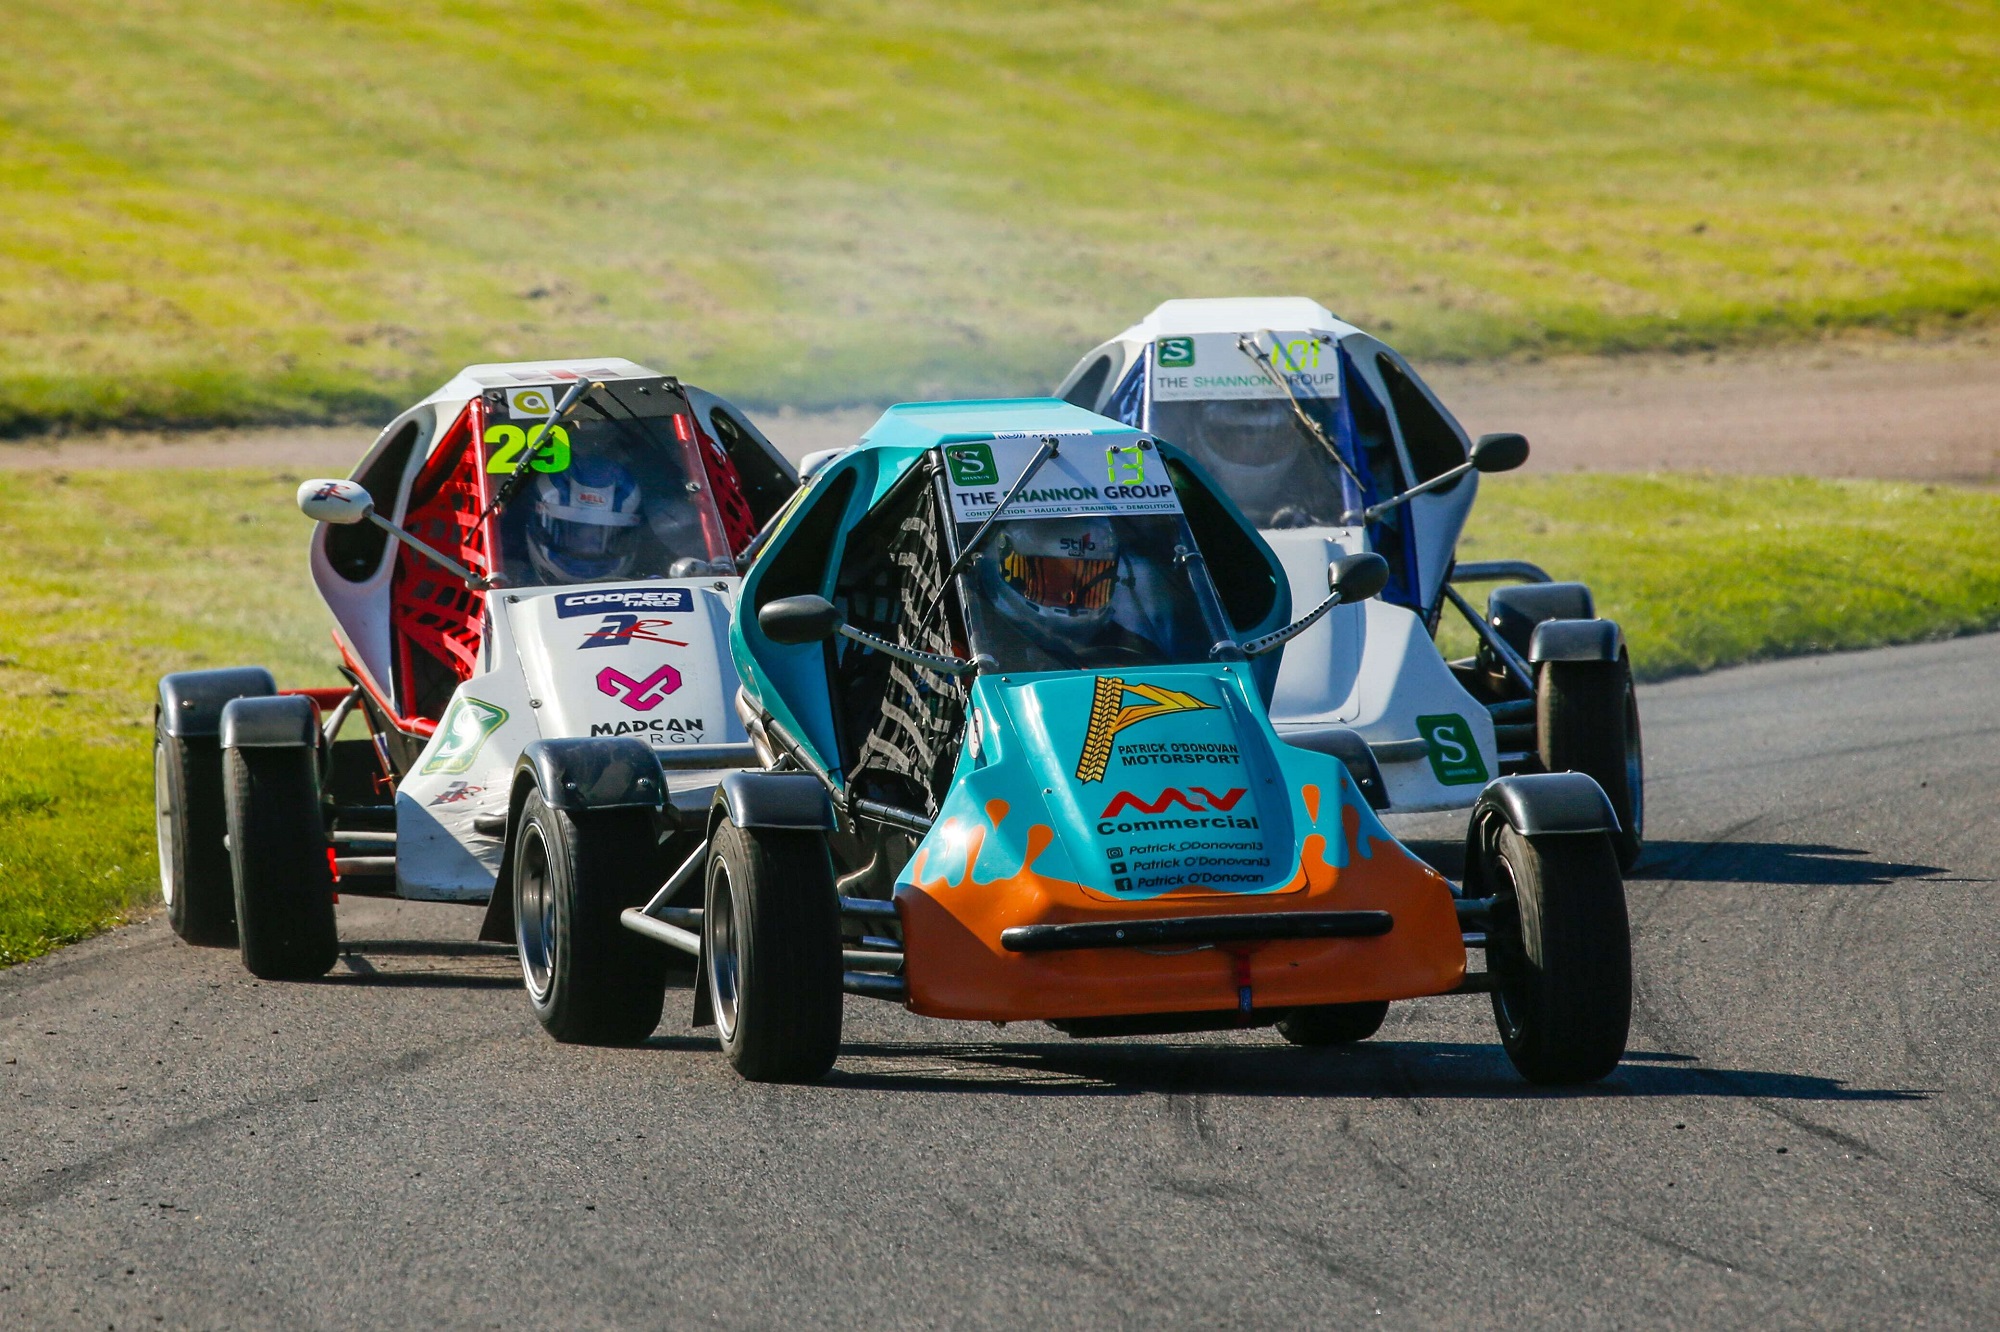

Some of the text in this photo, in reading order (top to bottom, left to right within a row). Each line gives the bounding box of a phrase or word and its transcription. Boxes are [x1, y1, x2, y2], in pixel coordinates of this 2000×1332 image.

[1271, 338, 1320, 372] 101
[1157, 376, 1188, 388] THE
[1193, 374, 1272, 388] SHANNON
[484, 424, 571, 474] 29
[1105, 447, 1144, 485] 13
[956, 491, 998, 506] THE
[1103, 484, 1172, 499] GROUP
[965, 508, 1026, 517] CONSTCTION
[1126, 502, 1176, 510] DEMOLITION
[564, 592, 682, 606] COOPER
[591, 718, 704, 737] MADCAN
[1118, 743, 1238, 754] PATRICK O'DONOVAN
[1121, 754, 1240, 766] MOTORSPORT
[1097, 816, 1259, 836] Commercial
[1133, 857, 1270, 871] Patrick O'Donovan13
[1138, 875, 1184, 888] Patrick
[1188, 873, 1264, 884] O'Donovan
